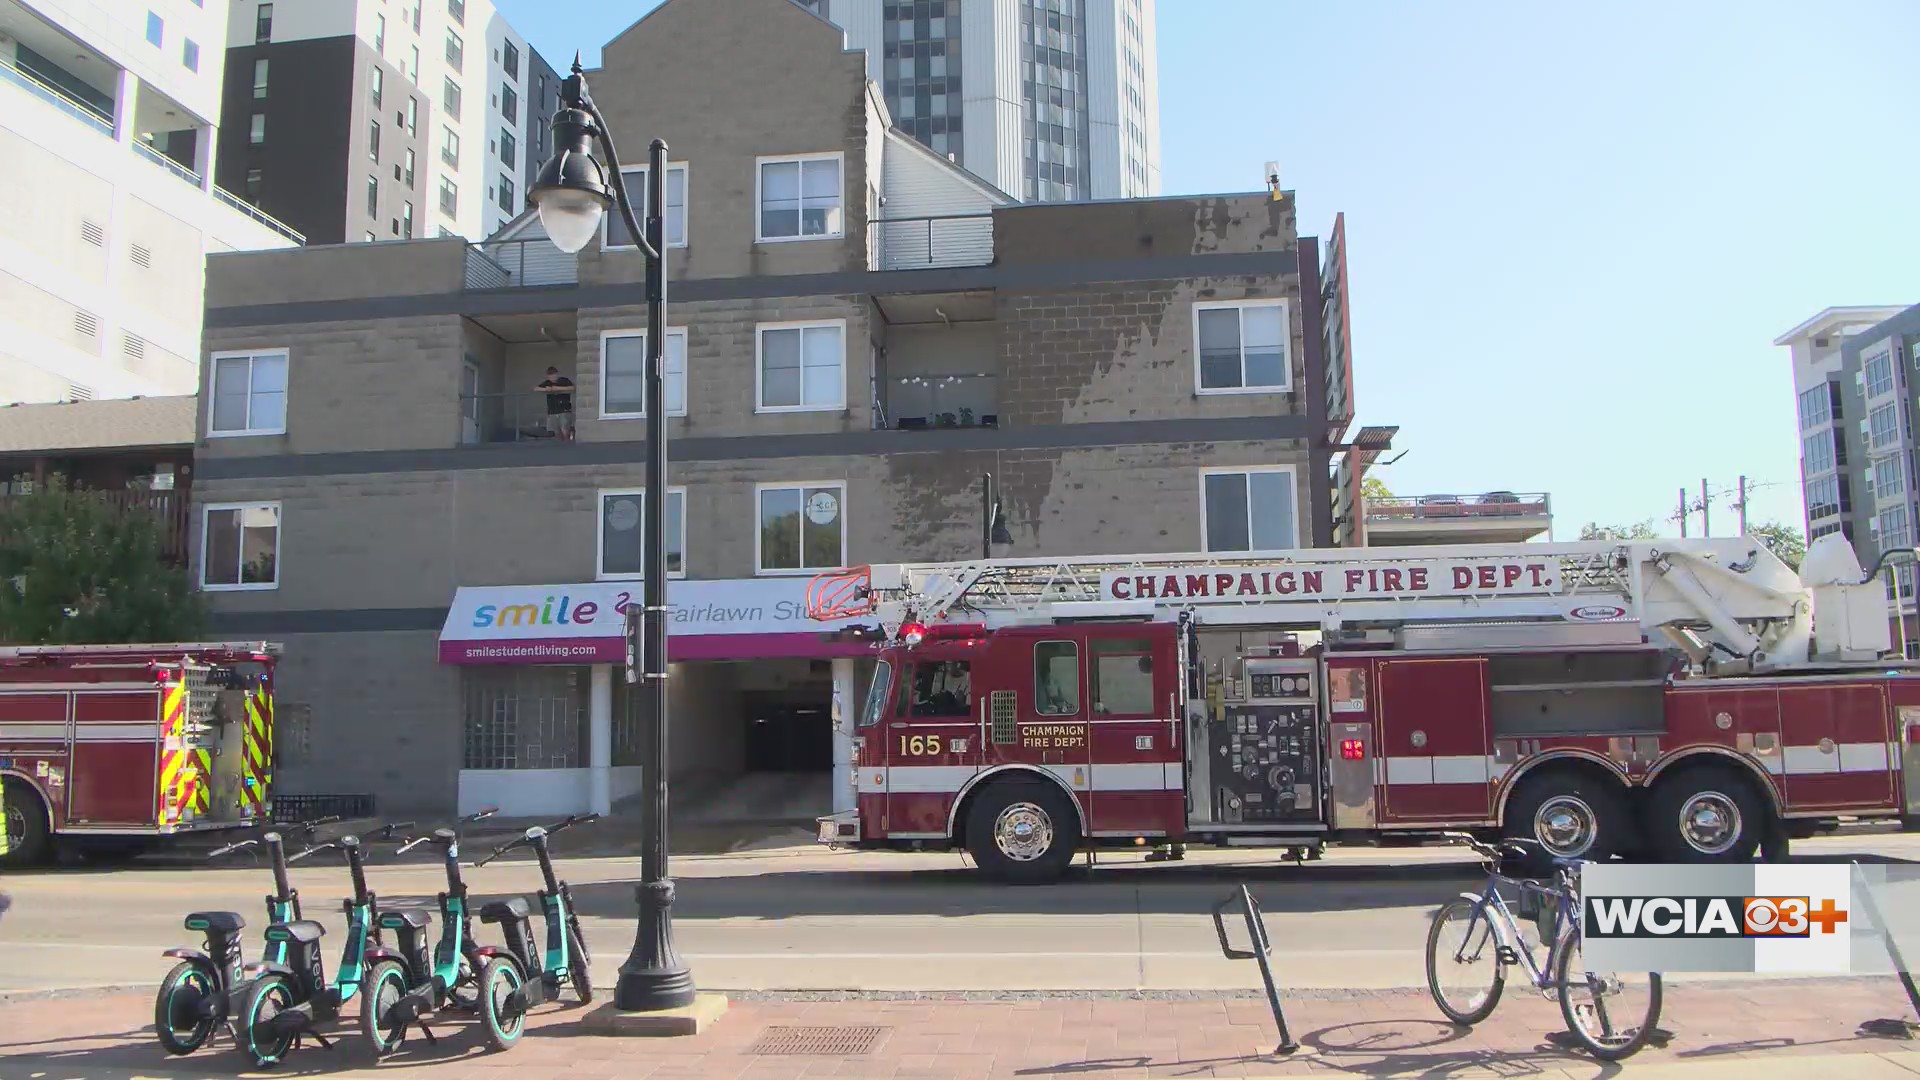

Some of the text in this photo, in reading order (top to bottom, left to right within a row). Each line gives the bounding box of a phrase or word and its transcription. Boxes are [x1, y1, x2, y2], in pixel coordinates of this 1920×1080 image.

[1111, 564, 1553, 599] CHAMPAIGN FIRE DEPT.
[472, 596, 598, 628] smile
[666, 602, 763, 623] Fairlawn
[466, 645, 596, 658] smilestudentliving.com
[1022, 726, 1084, 736] CHAMPAIGN
[1023, 736, 1085, 747] FIRE DEPT.
[900, 735, 941, 756] 165
[311, 944, 322, 990] veo
